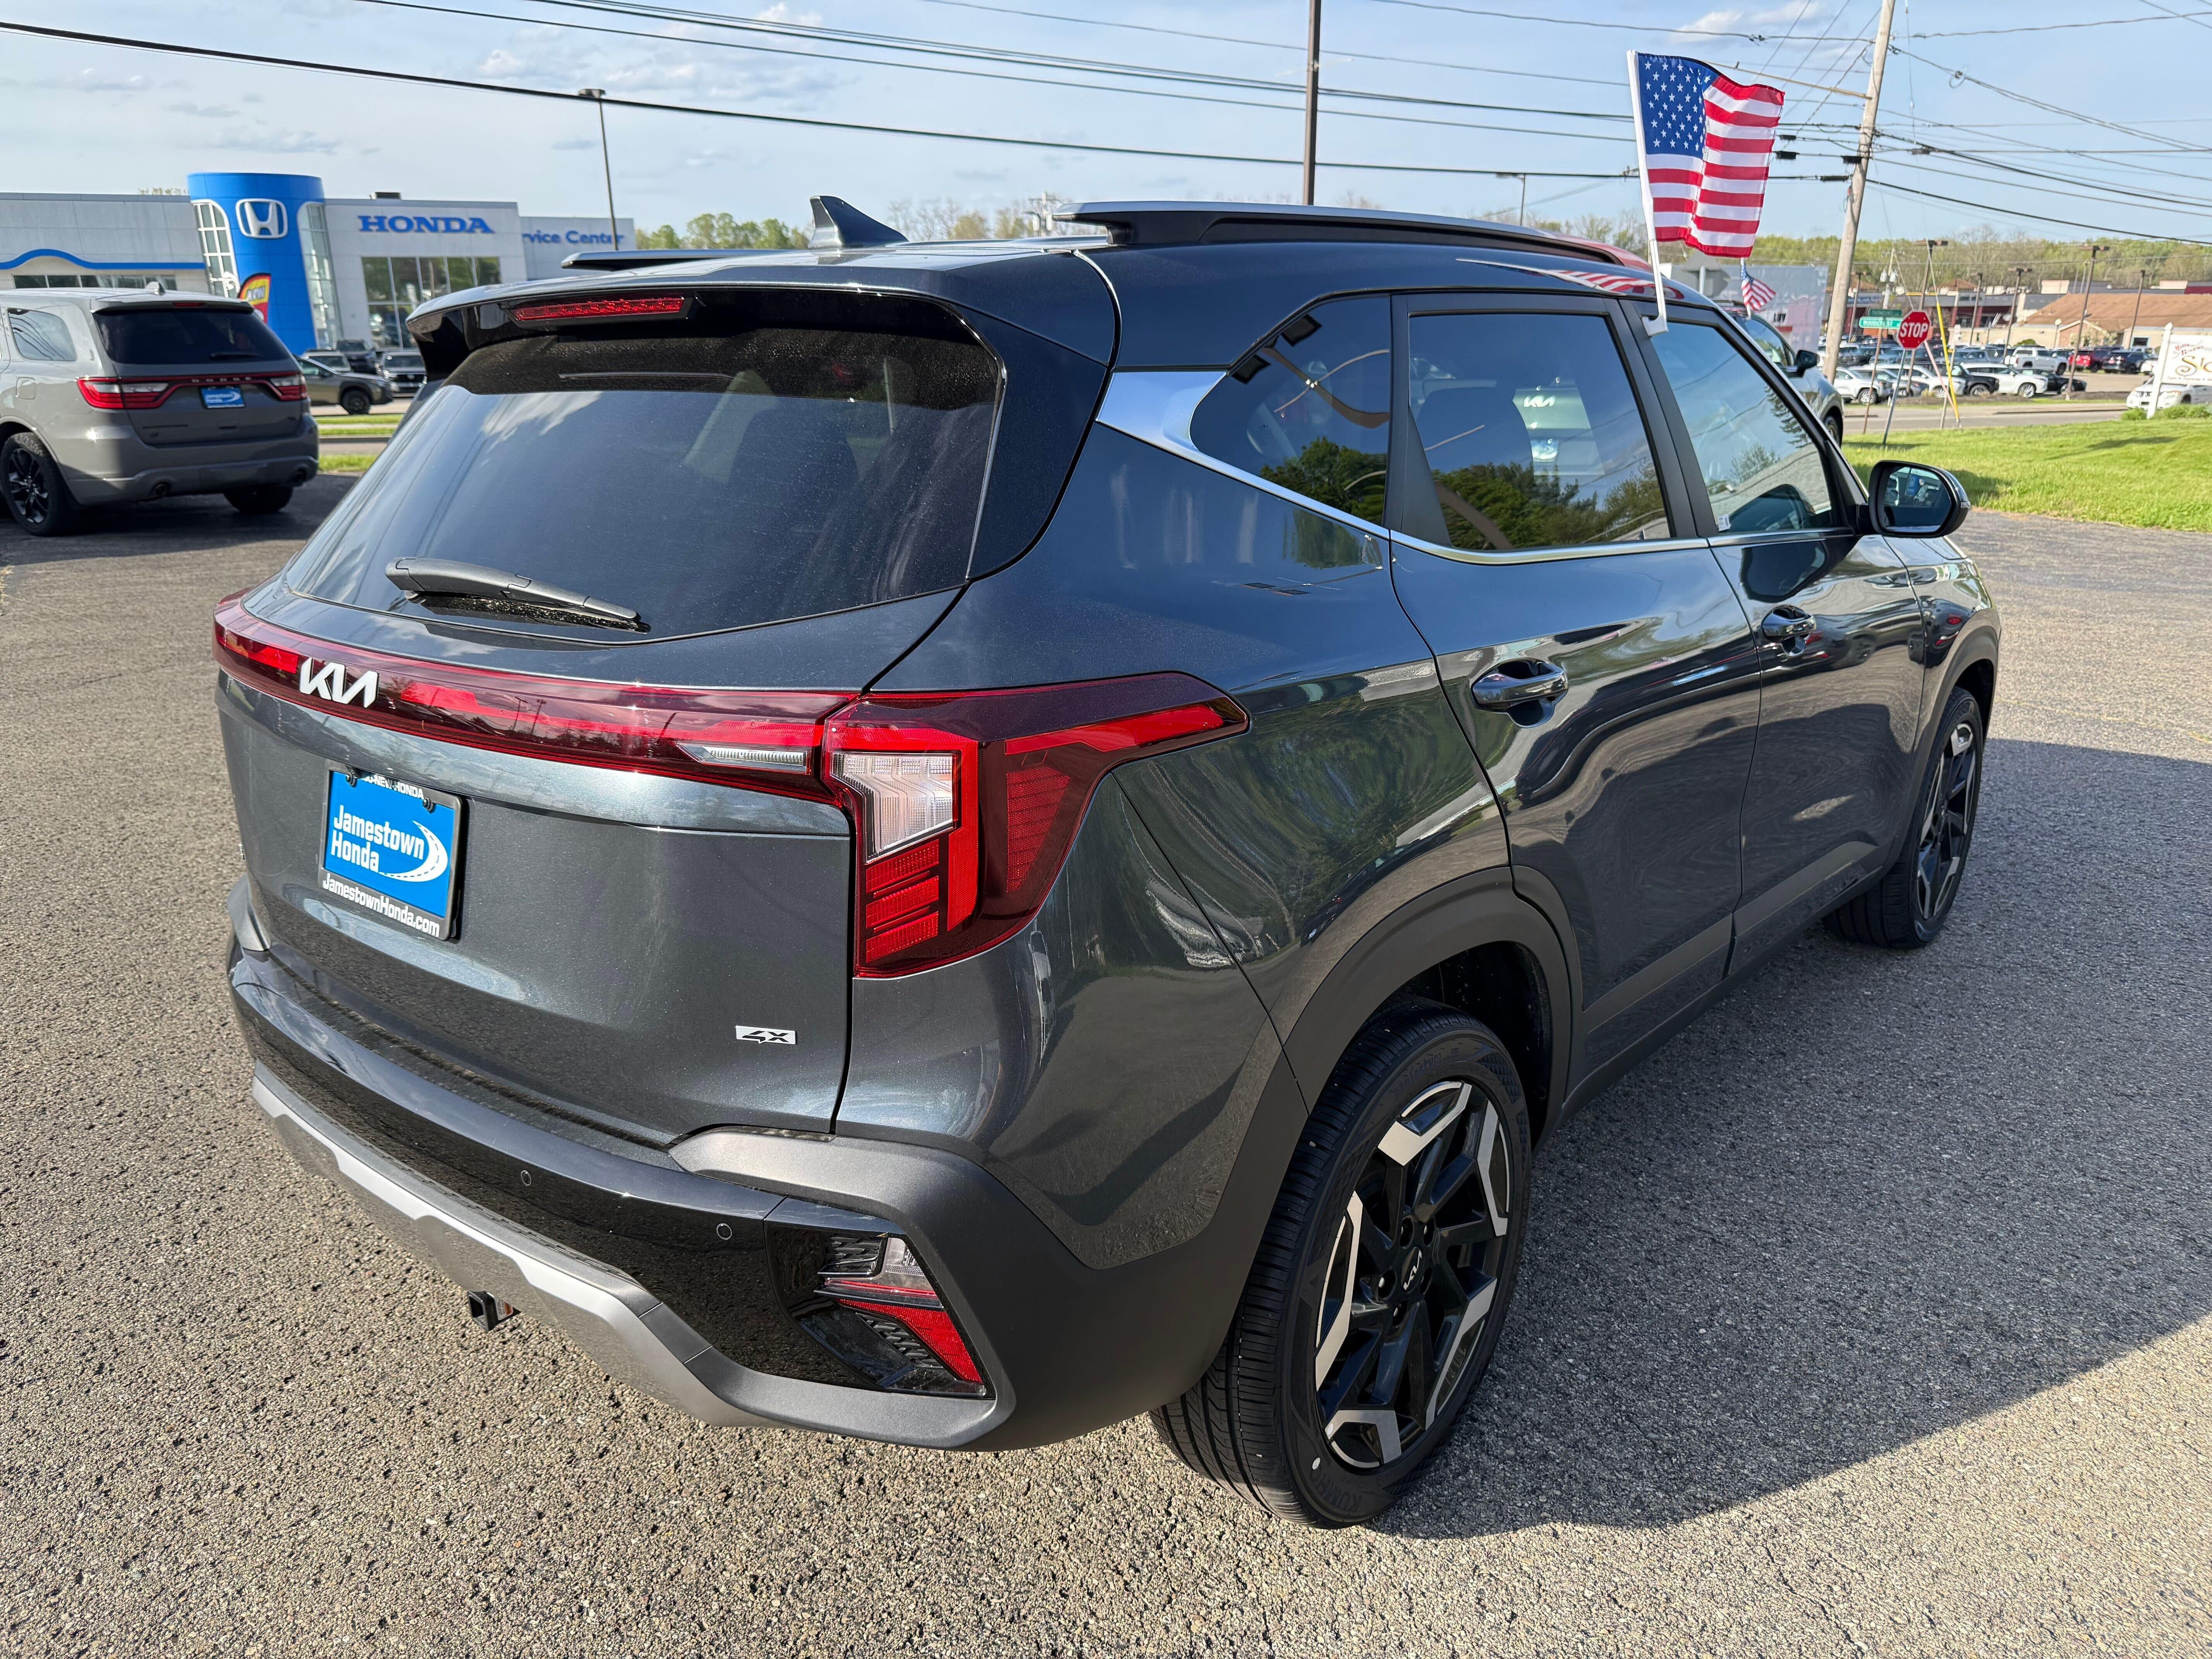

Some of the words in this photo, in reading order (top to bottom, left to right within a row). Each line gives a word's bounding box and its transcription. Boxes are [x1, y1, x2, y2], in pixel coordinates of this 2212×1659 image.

[357, 216, 495, 233] HONDA
[522, 229, 561, 244] rvice
[1900, 322, 1928, 338] STOP
[300, 657, 378, 708] KIA
[331, 830, 380, 873] Honda
[333, 804, 425, 860] Jamestown
[323, 872, 440, 938] JamestownHonda.com
[1403, 1250, 1422, 1290] KIA
